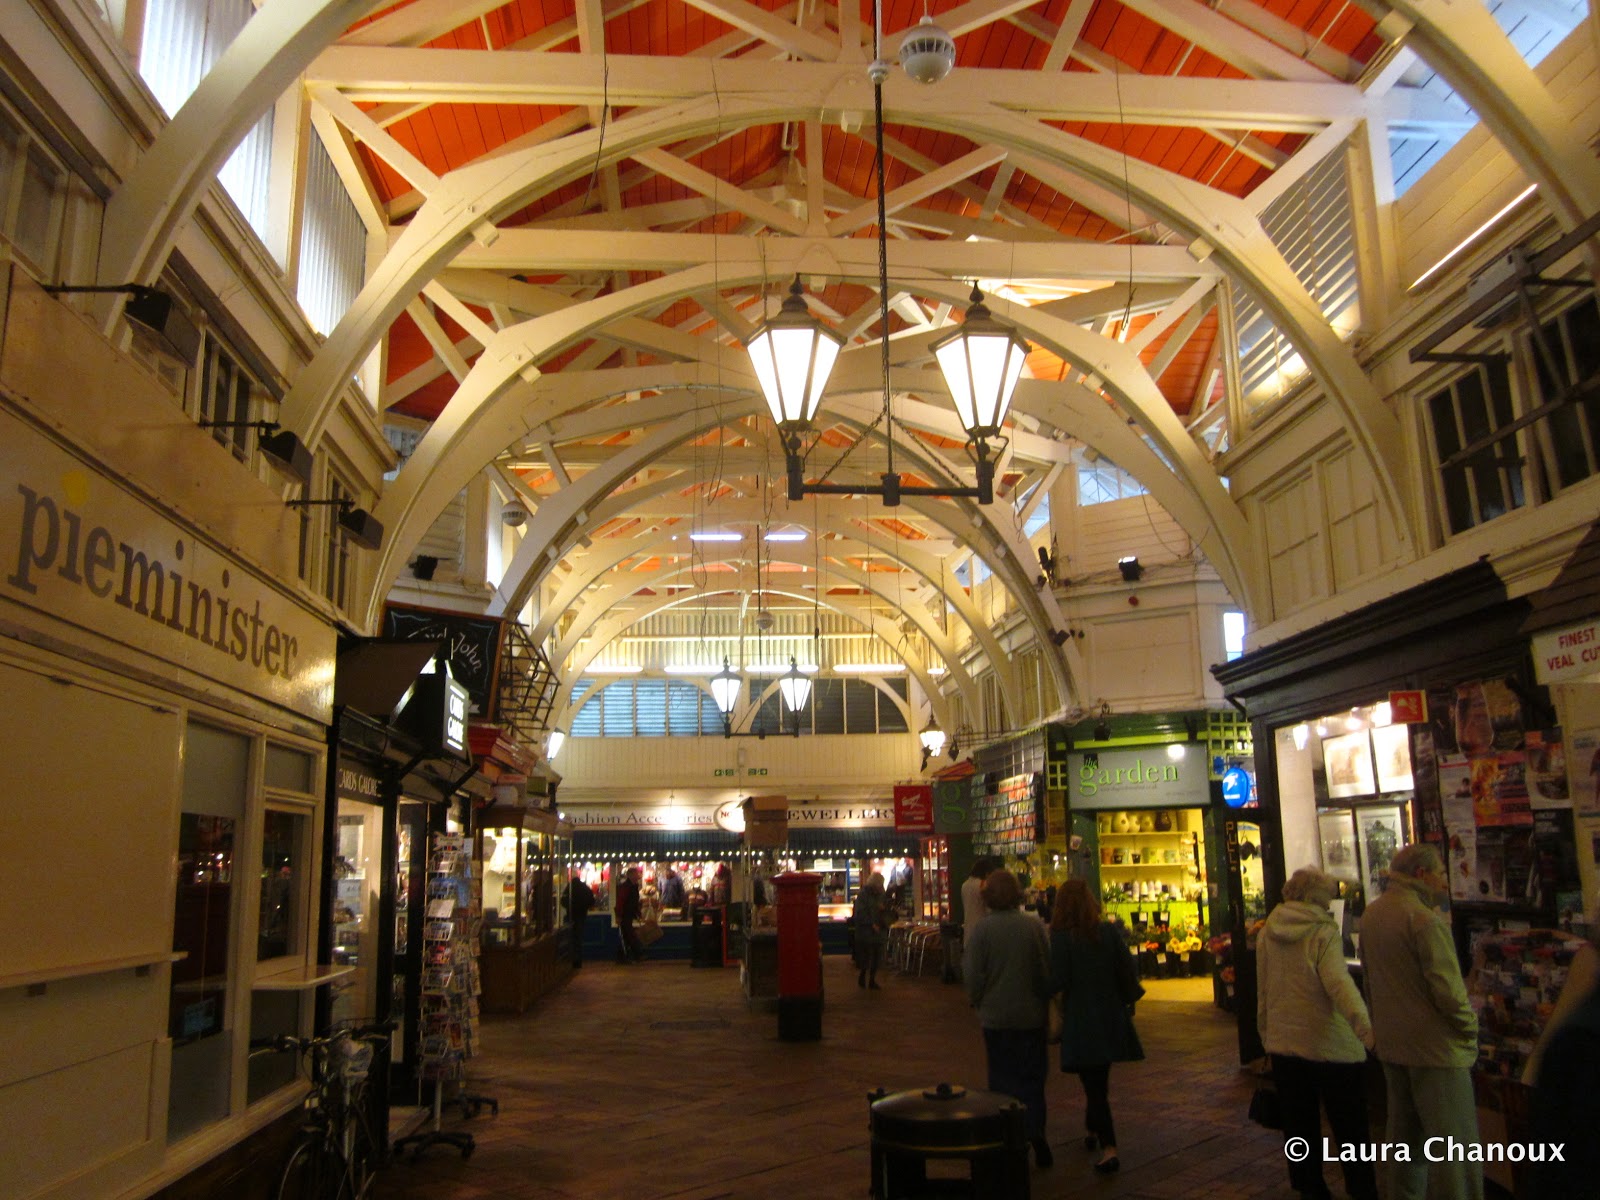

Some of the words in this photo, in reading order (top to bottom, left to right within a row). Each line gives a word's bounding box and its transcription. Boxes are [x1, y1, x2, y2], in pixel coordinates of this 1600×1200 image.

[8, 472, 298, 680] pieminister
[1558, 627, 1595, 649] FINEST
[453, 632, 482, 674] John
[1547, 654, 1576, 671] VEAL
[1080, 759, 1179, 796] garden
[571, 811, 620, 824] ashion
[625, 812, 712, 824] Acceries
[787, 809, 894, 820] EWELLER
